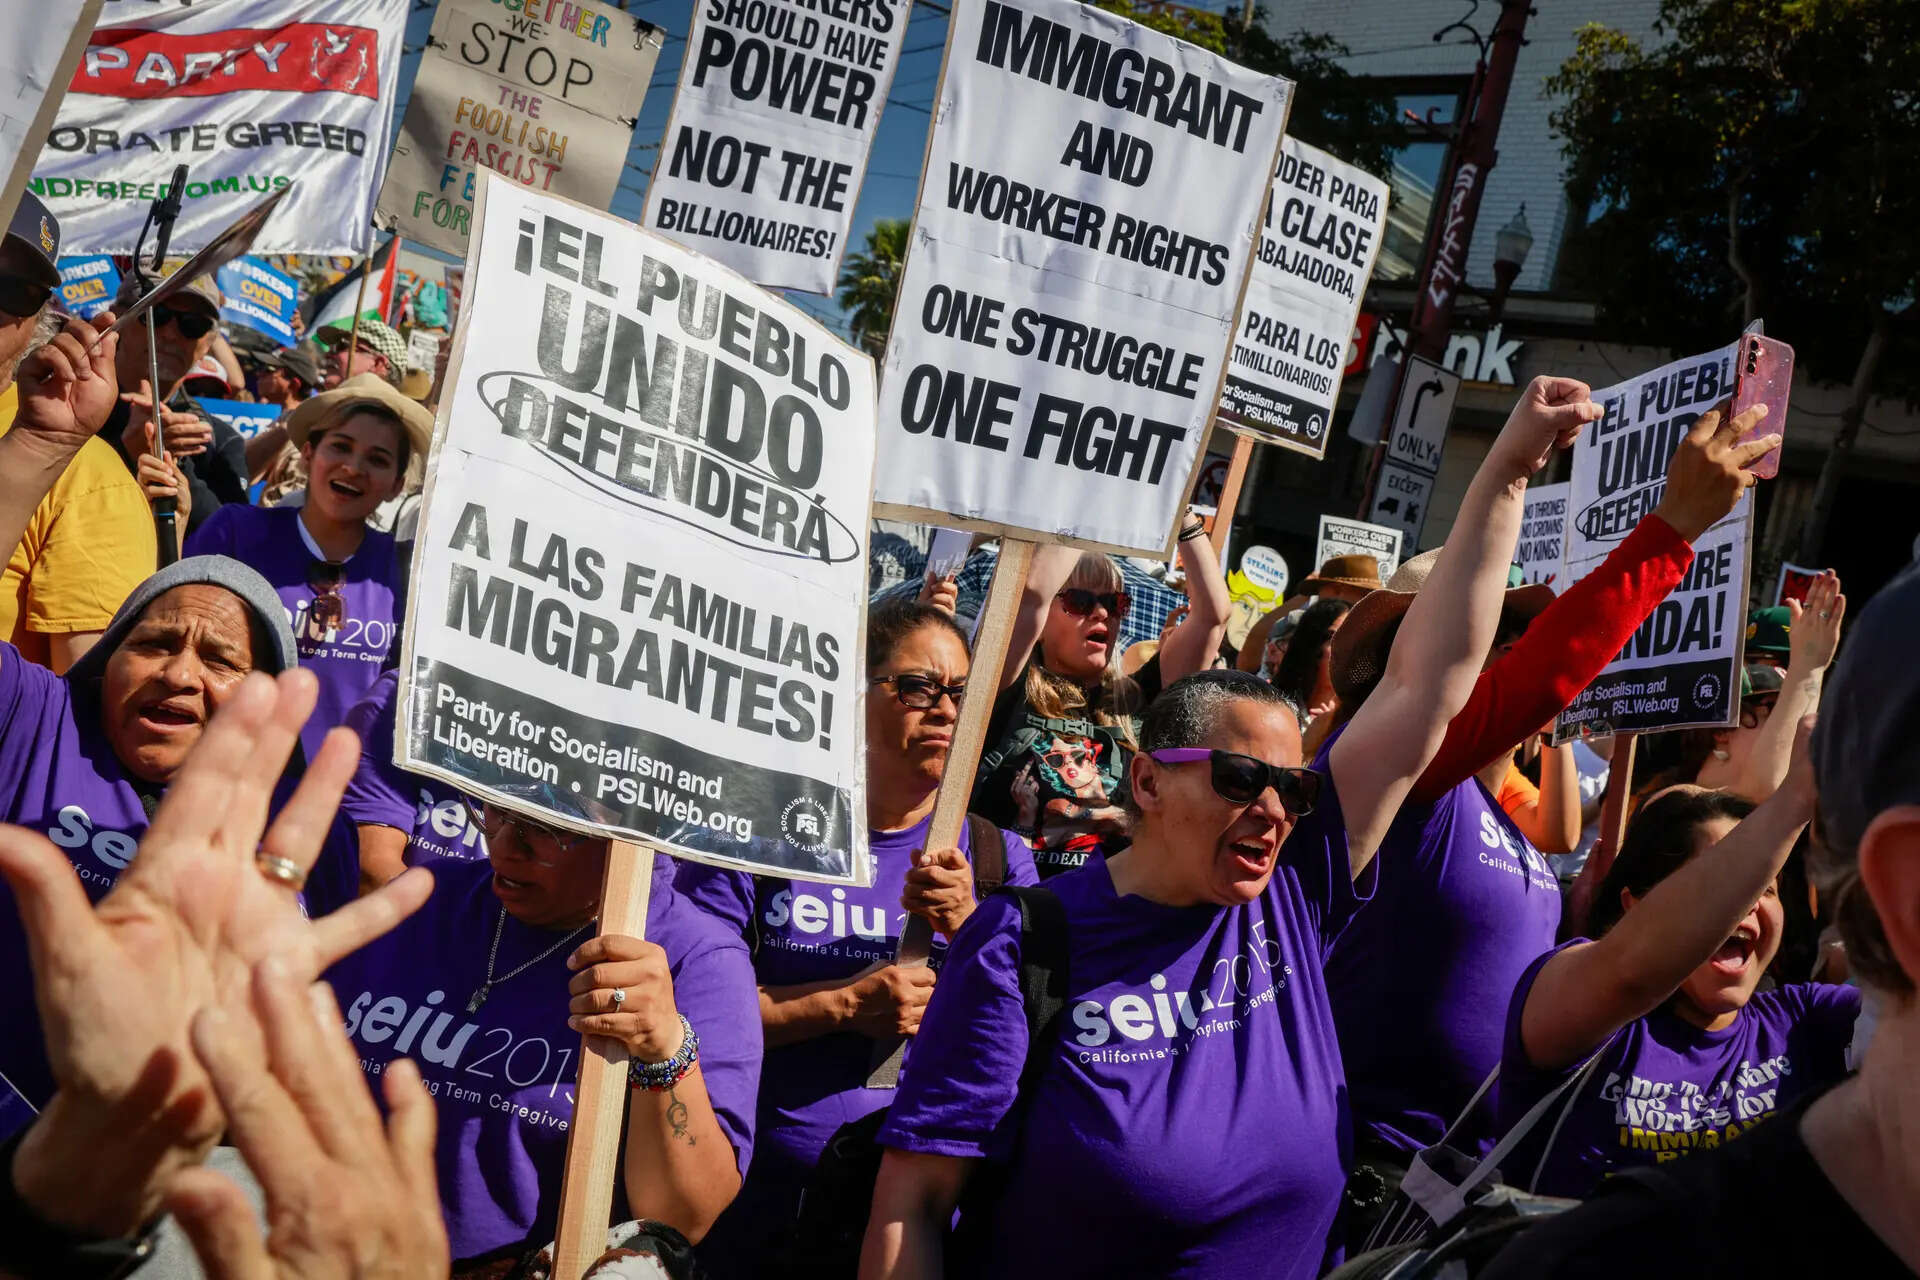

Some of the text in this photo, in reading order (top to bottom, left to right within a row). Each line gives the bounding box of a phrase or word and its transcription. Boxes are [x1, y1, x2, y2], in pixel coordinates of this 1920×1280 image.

[461, 21, 594, 98] STOP
[706, 0, 889, 71] SHOULD HAVE
[498, 85, 543, 119] THE
[692, 25, 876, 130] POWER
[976, 1, 1264, 154] IMMIGRANT
[225, 121, 366, 157] GREED
[455, 96, 568, 162] FOOLISH
[1059, 119, 1154, 188] AND
[447, 130, 562, 191] FASCIST
[668, 125, 853, 212] NOT THE
[946, 161, 1230, 286] WORKER RIGHTS
[1328, 175, 1378, 223] PARA
[656, 198, 837, 260] BILLIONAIRES!
[1281, 197, 1371, 268] CLASE
[60, 259, 111, 282] RKERS
[63, 278, 105, 299] OVER
[241, 280, 282, 312] OVER
[637, 254, 851, 411] PUEBLO
[922, 284, 1204, 400] ONE STRUGGLE
[1244, 311, 1300, 356] PARA
[1304, 333, 1340, 370] LOS
[536, 281, 824, 490] UNIDO
[1230, 344, 1332, 396] TIMILLONARIOS!
[900, 363, 1187, 485] ONE FIGHT
[1233, 385, 1274, 410] Socialism
[1274, 402, 1293, 416] and
[1244, 404, 1299, 434] PSLWeb.org
[500, 377, 832, 565] DEFENDERÁ
[1399, 432, 1435, 460] ONLY
[1388, 474, 1424, 496] EXCEPT
[1535, 499, 1566, 518] THRONES
[1328, 524, 1394, 545] WORKERS OVER
[1519, 538, 1560, 562] NO KINGS
[1532, 518, 1563, 538] CROWNS
[448, 502, 840, 682] A LAS FAMILIAS
[445, 562, 834, 751] MIGRANTES!
[1611, 591, 1726, 663] NDA!
[1560, 706, 1599, 725] Liberation
[1595, 681, 1645, 700] Socialism
[1646, 676, 1667, 695] and
[436, 682, 723, 800] Party for Socialism and
[433, 716, 752, 843] Liberation PSLWeb.org
[796, 813, 820, 836] PSL
[765, 888, 886, 943] seiu
[763, 933, 839, 956] California's
[846, 946, 880, 961] Long
[1072, 920, 1281, 1047] seiu 2015
[343, 990, 578, 1104] seiu 201
[1079, 1047, 1178, 1065] California's
[445, 1081, 482, 1104] Term
[489, 1093, 568, 1131] Caregive
[1736, 1088, 1777, 1119] for
